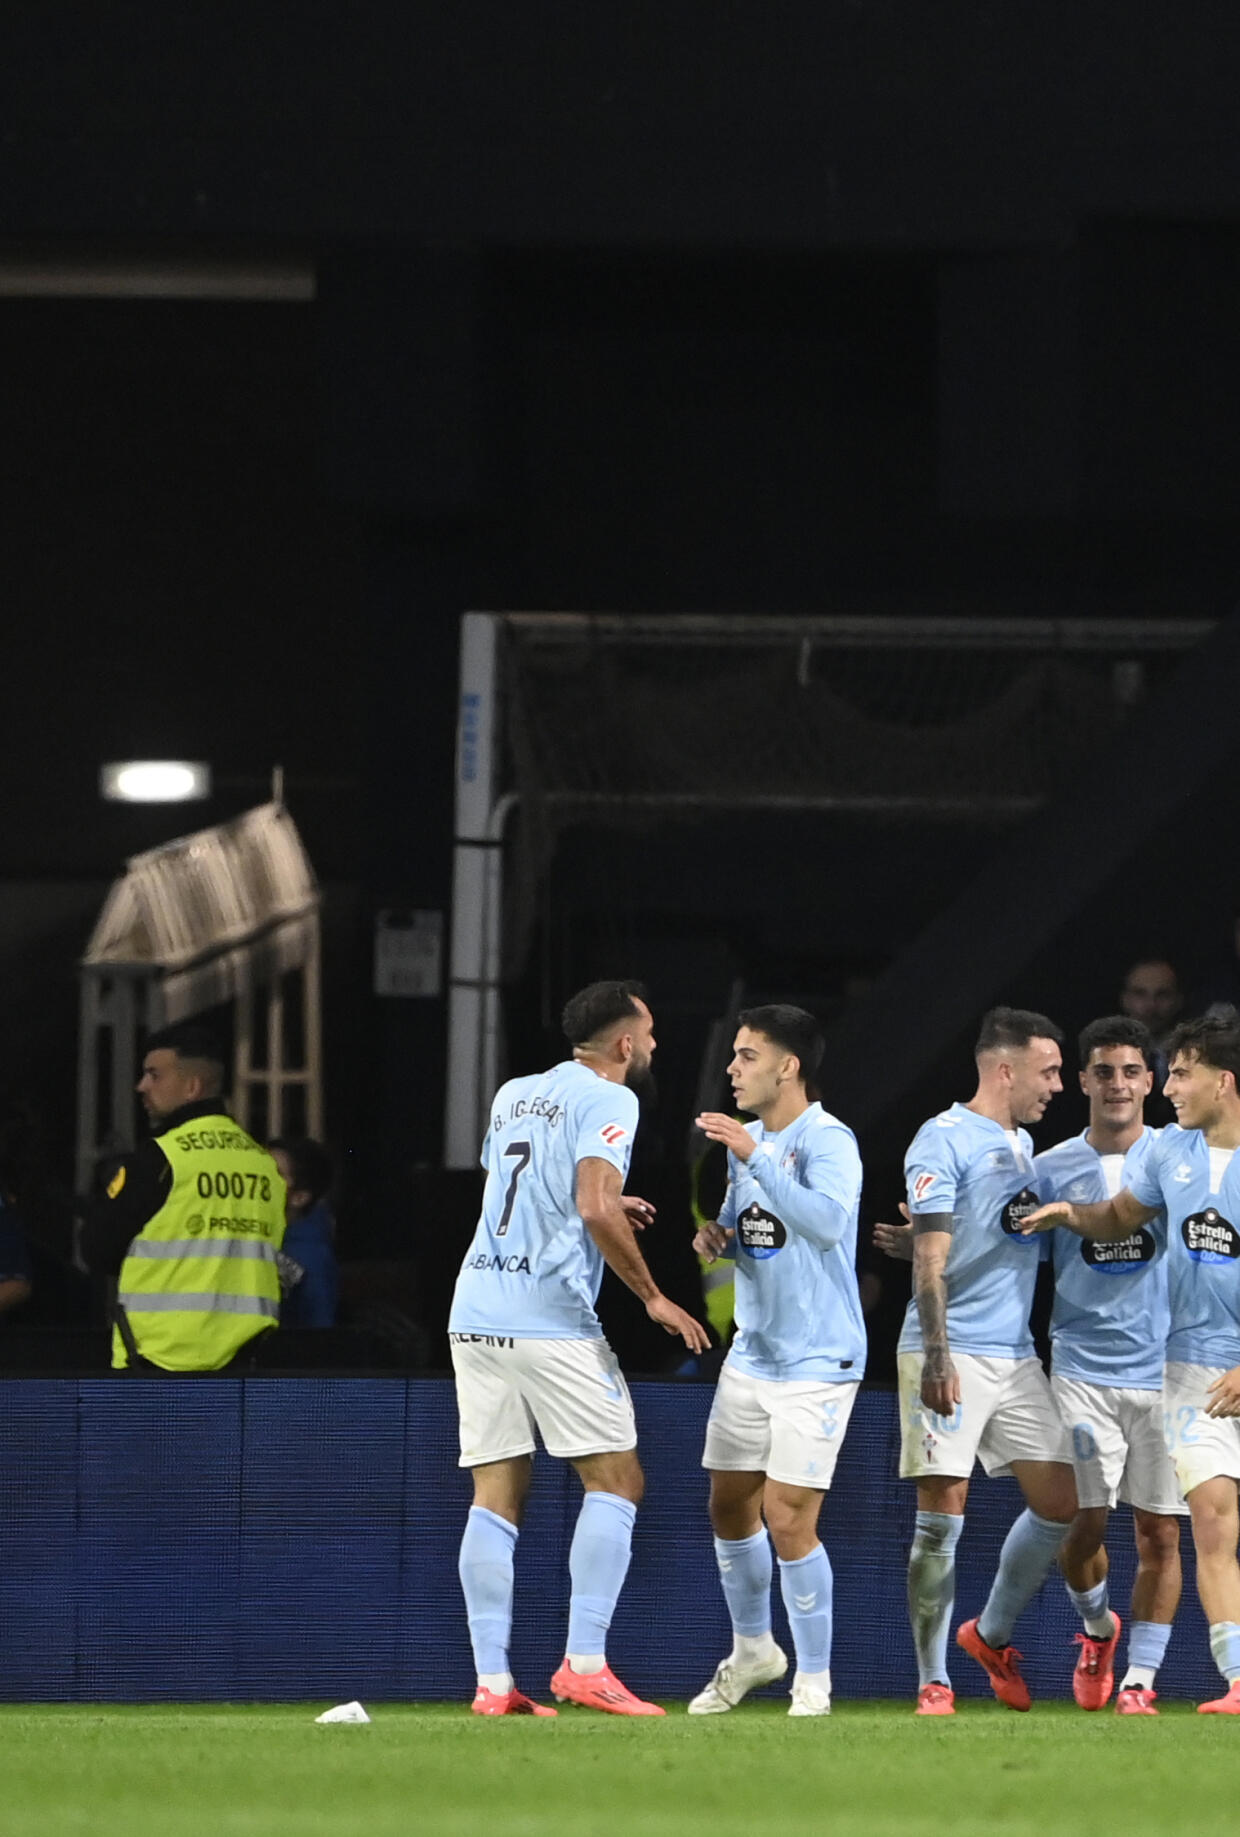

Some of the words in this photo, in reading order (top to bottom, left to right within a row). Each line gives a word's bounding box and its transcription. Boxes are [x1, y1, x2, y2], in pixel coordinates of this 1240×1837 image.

[175, 1131, 268, 1154] SEGUR
[197, 1172, 272, 1202] 00078
[495, 1141, 531, 1236] 7
[1188, 1220, 1233, 1242] Estrella
[1094, 1246, 1143, 1262] Galicia
[1188, 1233, 1231, 1254] Galicia
[463, 1254, 531, 1275] ABANCA
